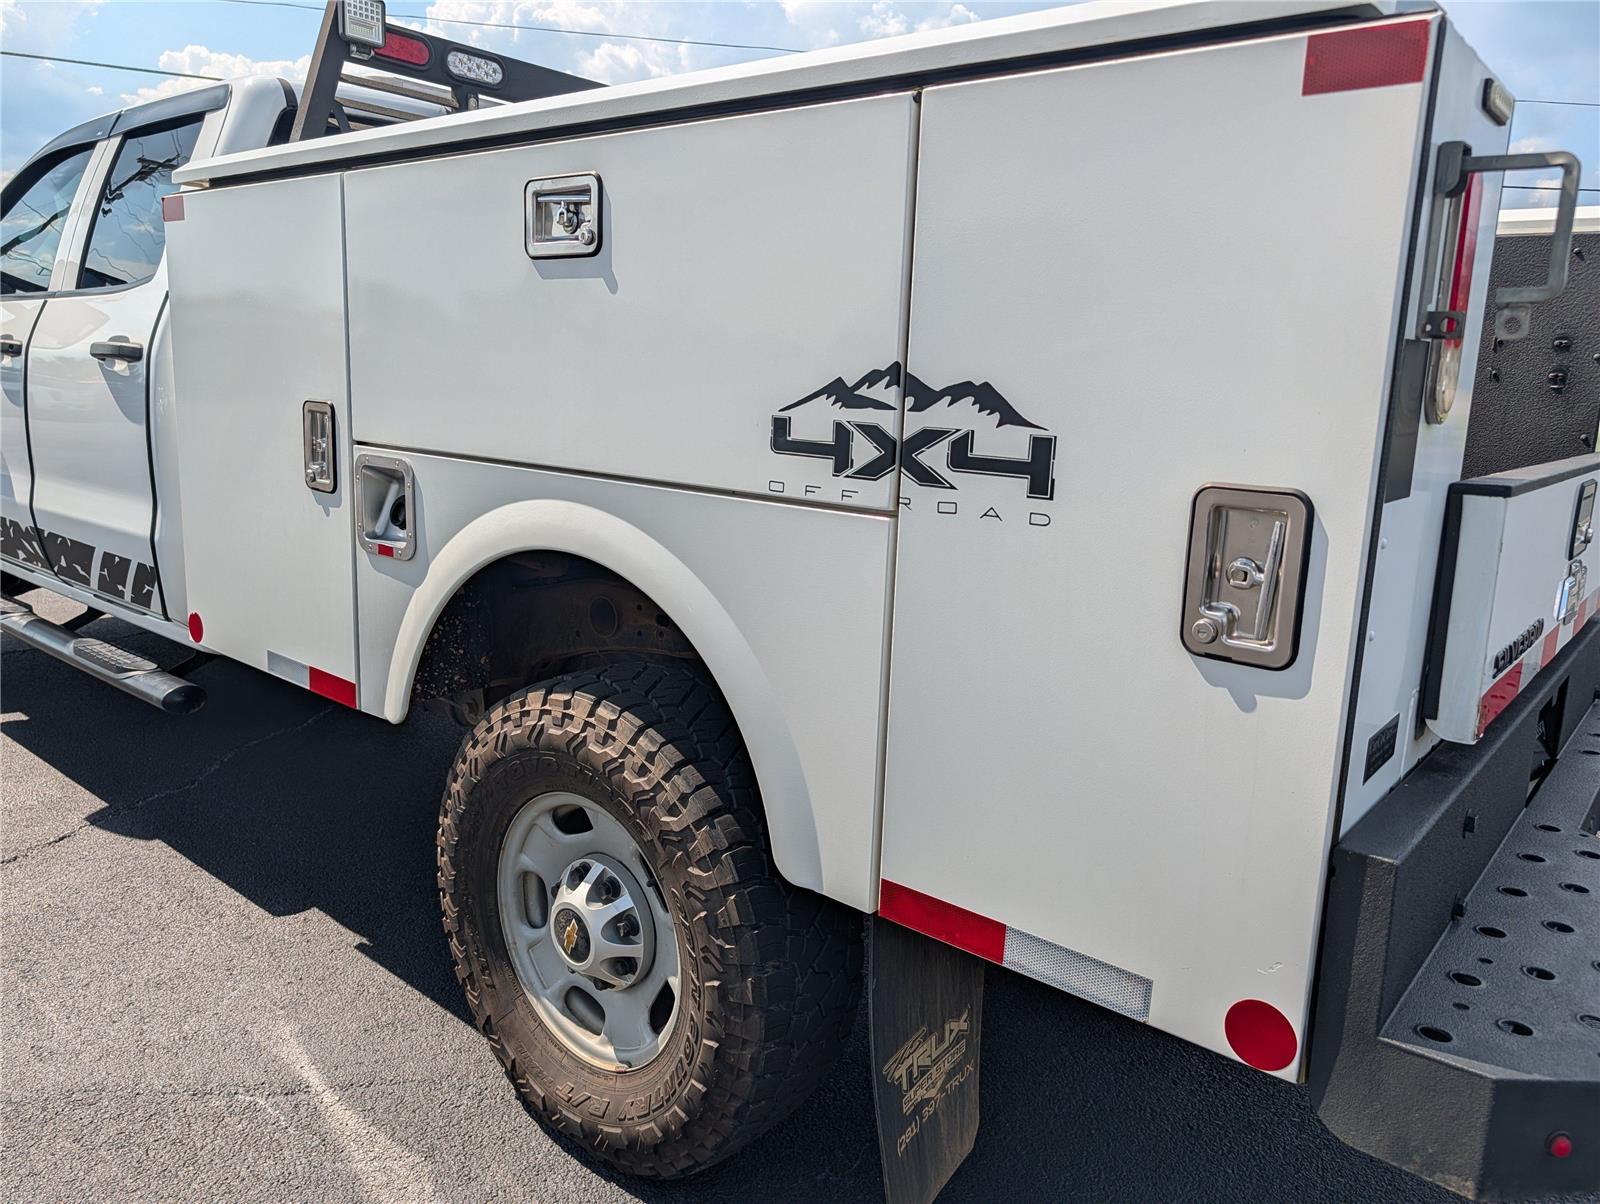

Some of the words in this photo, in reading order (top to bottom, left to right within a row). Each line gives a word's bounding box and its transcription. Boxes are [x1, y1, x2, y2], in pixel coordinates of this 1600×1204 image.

[770, 415, 1057, 500] 4X4
[768, 480, 859, 502] OFF
[898, 496, 1052, 528] ROAD
[617, 1010, 700, 1122] COUNTRY
[896, 1004, 970, 1093] TRUX
[903, 1071, 934, 1112] SUPER
[935, 1042, 967, 1078] STORE
[554, 1081, 610, 1119] R/T
[897, 1115, 921, 1158] (281)
[921, 1059, 975, 1124] 397-TRUX
